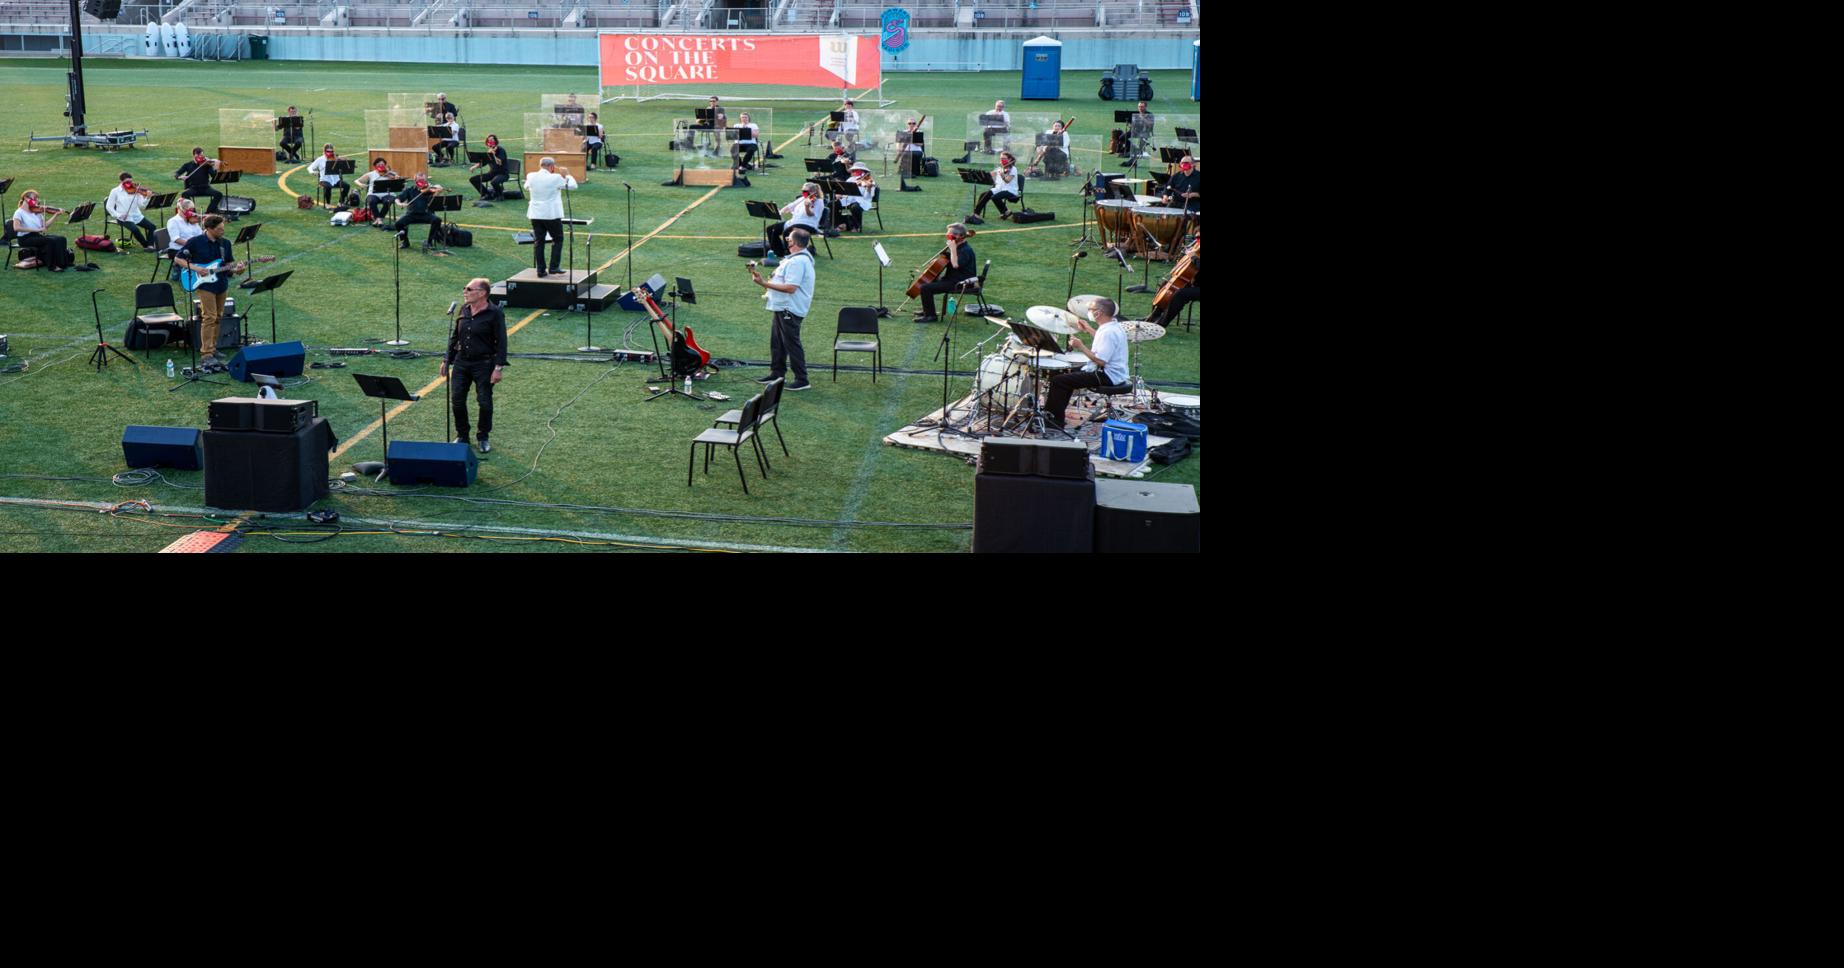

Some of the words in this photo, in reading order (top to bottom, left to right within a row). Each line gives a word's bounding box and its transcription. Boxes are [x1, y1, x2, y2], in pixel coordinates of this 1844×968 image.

[624, 36, 756, 51] CONCERTS
[625, 51, 658, 65] ON
[669, 51, 714, 65] THE
[625, 65, 719, 82] SQUARE
